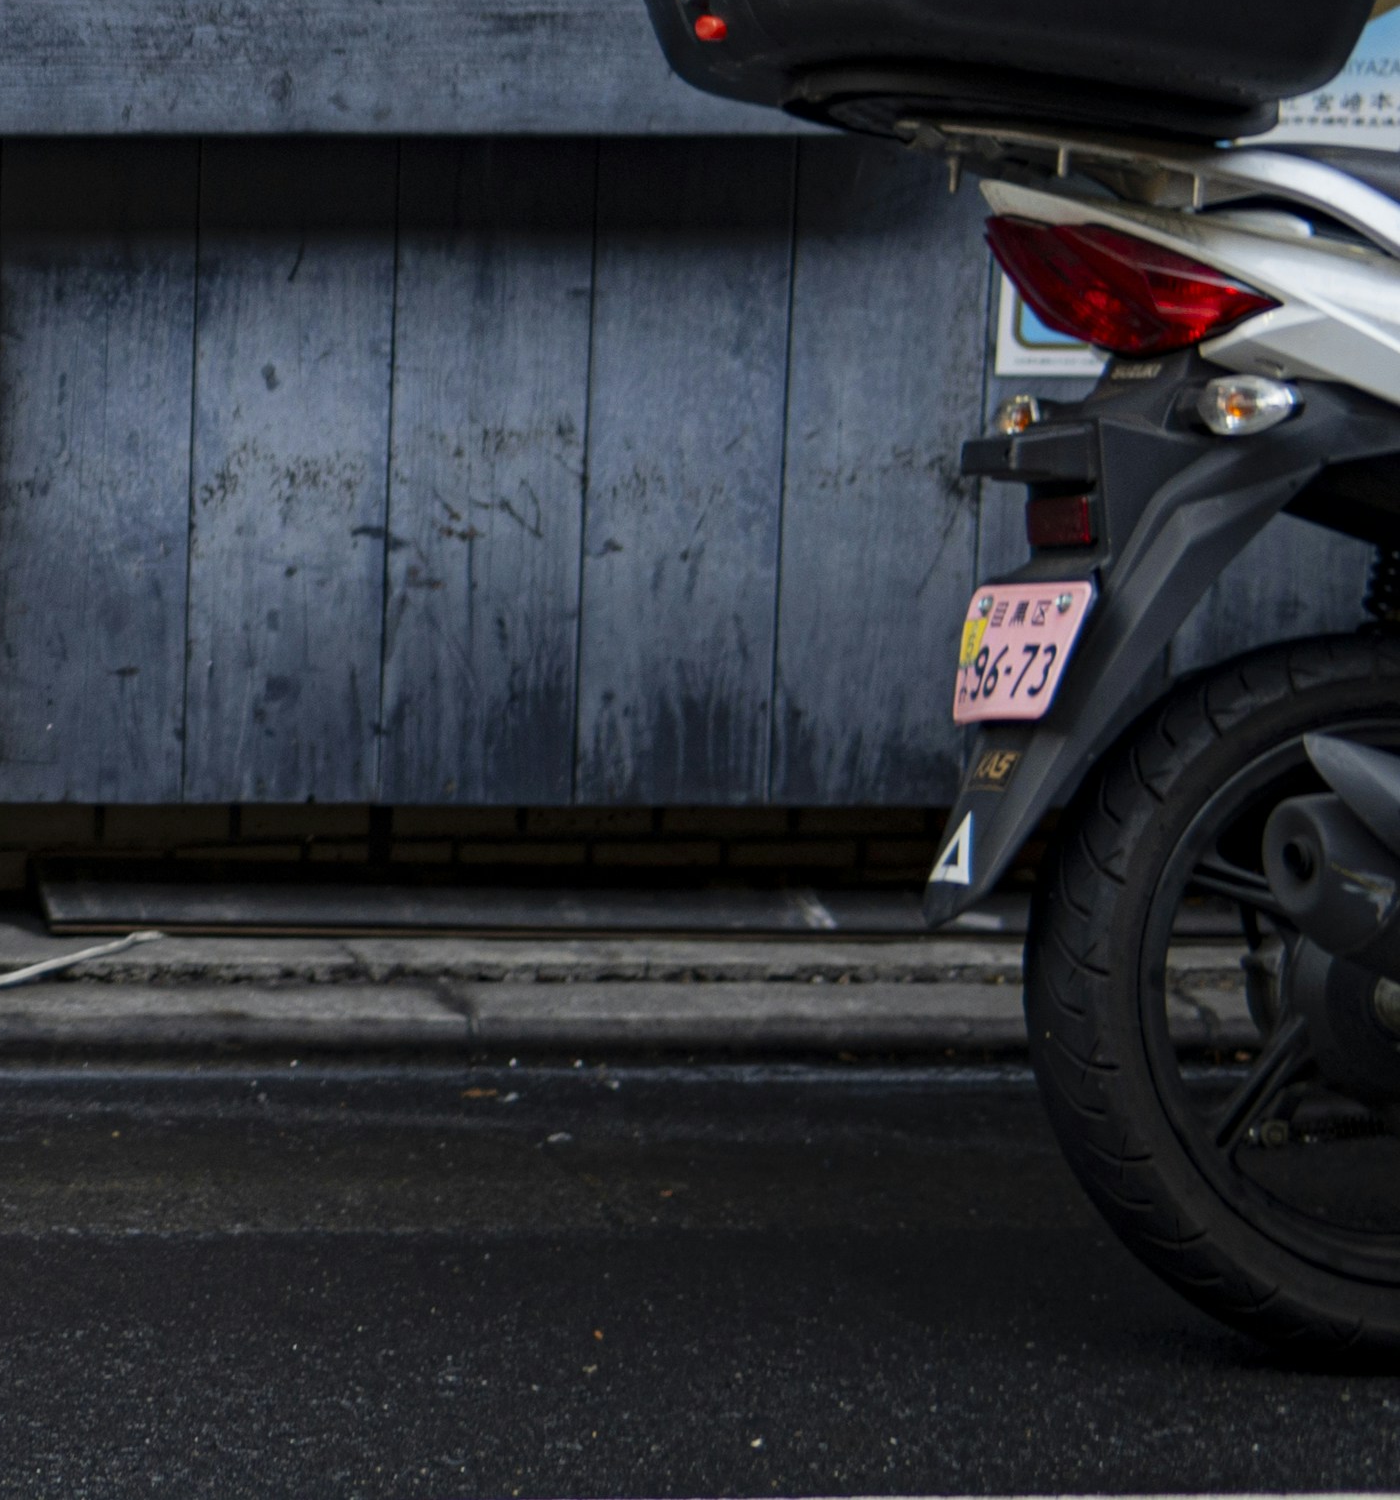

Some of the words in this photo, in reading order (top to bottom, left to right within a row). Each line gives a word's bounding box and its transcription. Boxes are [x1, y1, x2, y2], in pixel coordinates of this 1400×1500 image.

[990, 600, 1052, 628] 目黒区
[969, 643, 1058, 701] 96-73
